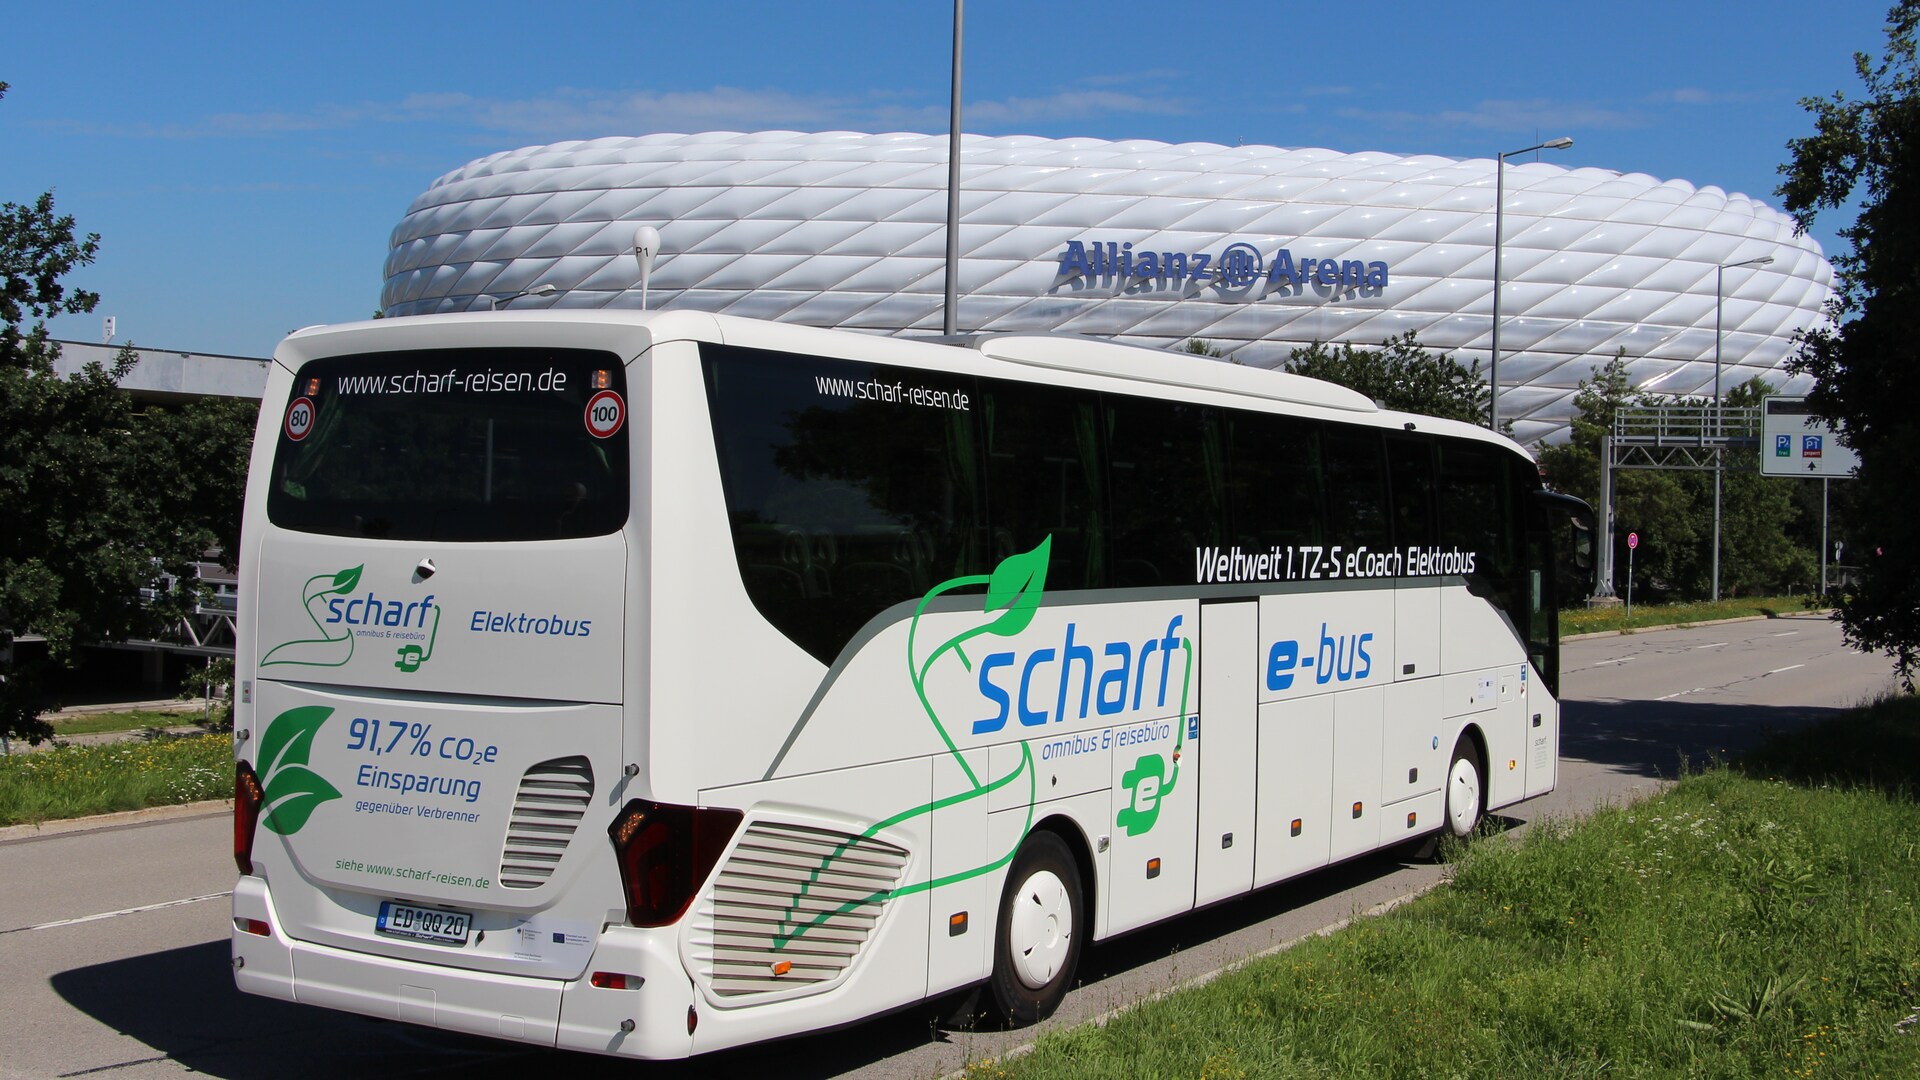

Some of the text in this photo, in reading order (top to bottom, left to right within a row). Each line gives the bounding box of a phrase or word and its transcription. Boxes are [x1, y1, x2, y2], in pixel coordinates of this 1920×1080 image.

[635, 246, 649, 258] P1
[1059, 240, 1389, 287] Allianz Arena
[337, 367, 567, 395] www.scharf-reisen.de
[815, 375, 970, 411] www.scharf-reisen.de
[290, 410, 309, 428] 80
[592, 406, 618, 424] 100
[1806, 440, 1818, 449] P1
[1196, 546, 1282, 583] Weltweit
[1345, 546, 1402, 578] eCoach
[1406, 545, 1476, 577] Elektrobus
[325, 592, 435, 628] scharf
[470, 610, 592, 637] Elektrobus
[356, 629, 384, 638] omnibus
[392, 631, 425, 640] reisebüro
[1266, 622, 1374, 691] e-bus
[971, 614, 1184, 735] scharf
[346, 717, 432, 757] 91,7%
[1042, 721, 1170, 761] omnibus & reisebüro
[356, 764, 482, 803] Einsparung
[355, 800, 481, 823] gegenüber Verbrenner
[335, 859, 490, 890] siehe www.scharf-reisen.de
[393, 907, 464, 936] ED QQ 20
